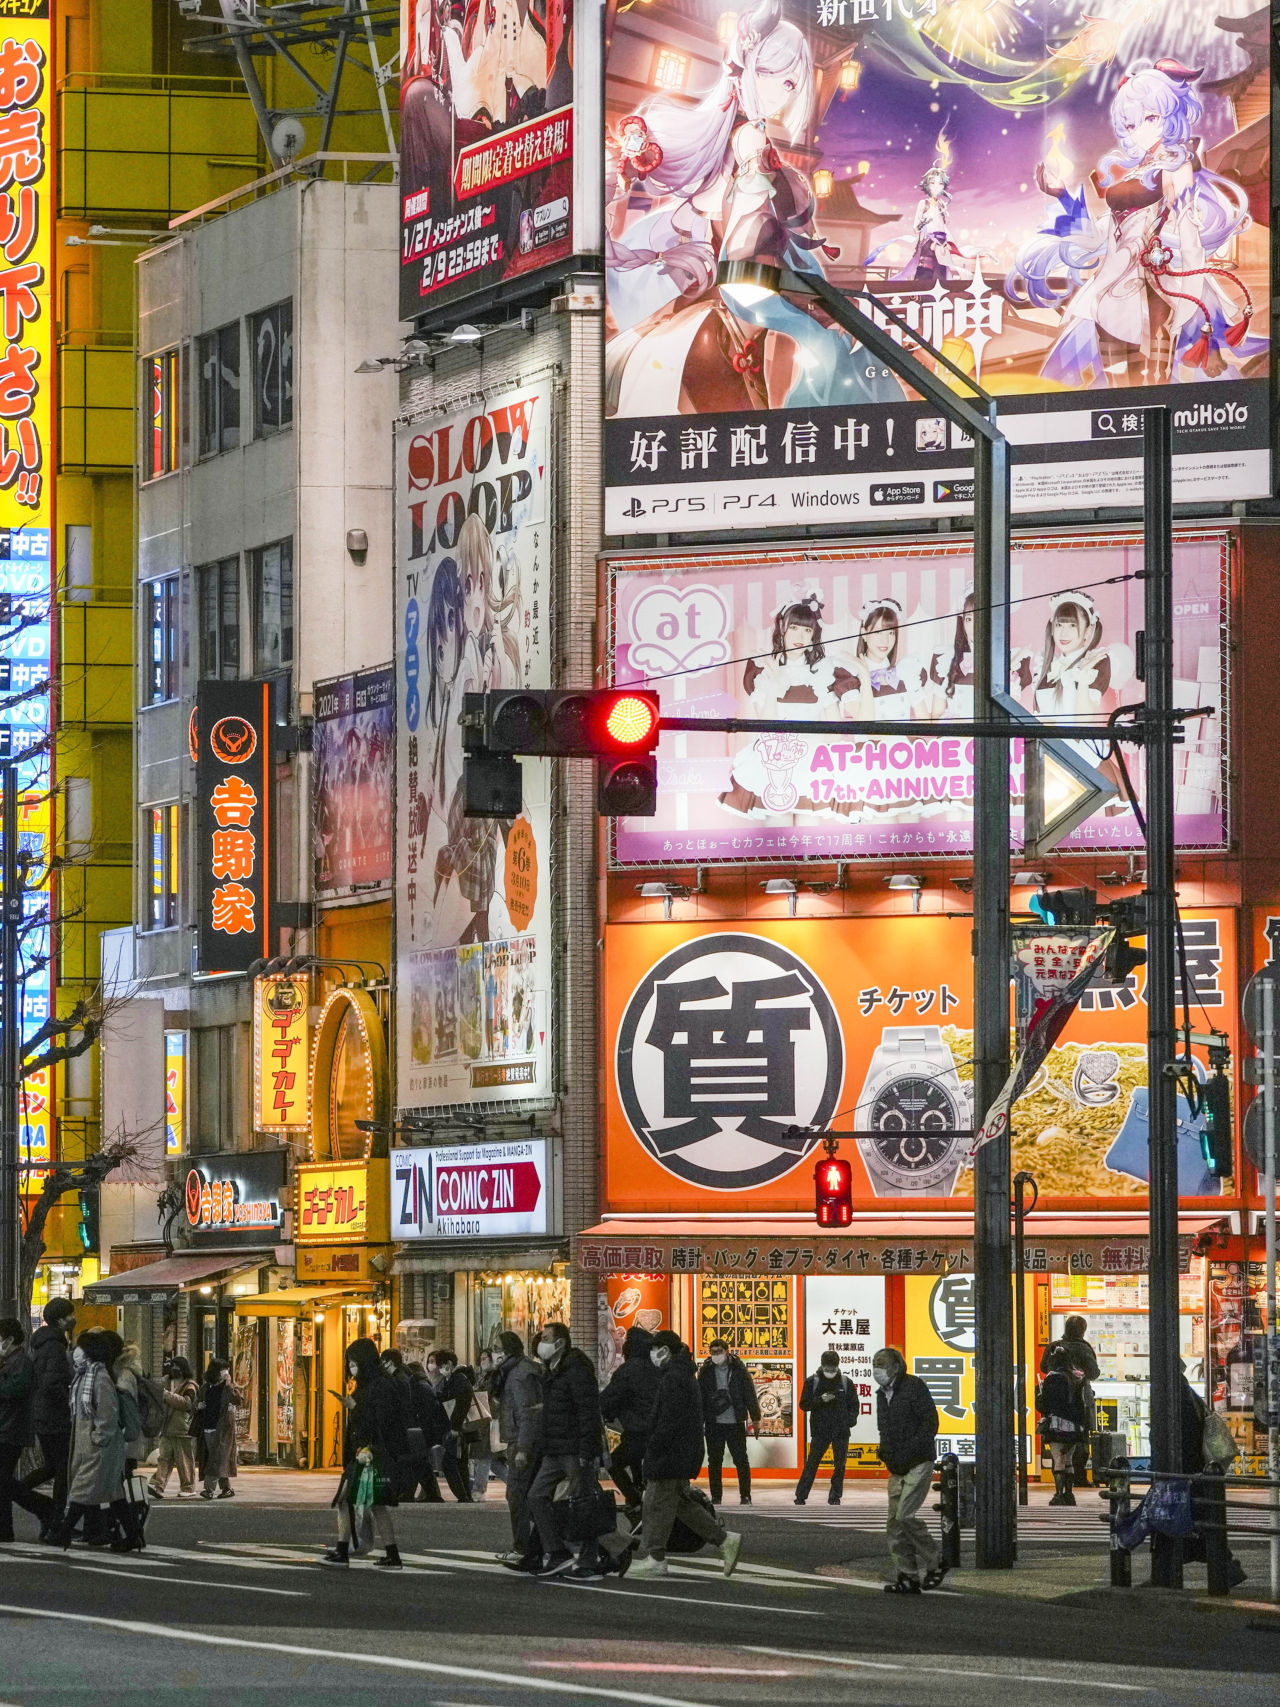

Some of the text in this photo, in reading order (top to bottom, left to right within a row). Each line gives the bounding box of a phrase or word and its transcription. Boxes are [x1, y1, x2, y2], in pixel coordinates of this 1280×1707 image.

[460, 119, 570, 193] 期間限定着せ替え登場!
[403, 218, 433, 258] 1/27
[422, 233, 500, 288] 2/9 23:59まで
[1121, 413, 1144, 433] 検
[1173, 402, 1249, 427] miHoYo
[407, 396, 540, 494] SLOW
[629, 417, 896, 473] 好評配信中!
[723, 492, 777, 511] PS4
[791, 490, 861, 509] Windows
[886, 485, 921, 496] App Store
[407, 469, 533, 562] LOOP
[652, 497, 706, 514] PS5
[12, 533, 49, 556] 中古
[406, 572, 419, 598] TV
[1174, 602, 1210, 616] OPEN
[655, 603, 702, 641] at
[12, 663, 49, 687] 中古
[318, 693, 339, 718] 2021年
[809, 739, 960, 773] AT-HOME
[809, 778, 857, 802] 17th
[210, 775, 258, 935] 吉野家
[857, 984, 961, 1016] チケット
[644, 968, 814, 1158] 質
[395, 1153, 412, 1168] COMIC
[435, 1150, 458, 1162] Professional
[459, 1149, 475, 1162] Support
[482, 1147, 502, 1162] Magazine
[201, 1180, 234, 1224] 吉野家
[395, 1152, 434, 1235] ZIN
[438, 1168, 514, 1211] COMIC ZIN
[437, 1217, 480, 1235] Akihabara
[581, 1245, 665, 1270] 高価買取
[833, 1308, 858, 1317] チケット
[821, 1318, 871, 1336] 大黒屋
